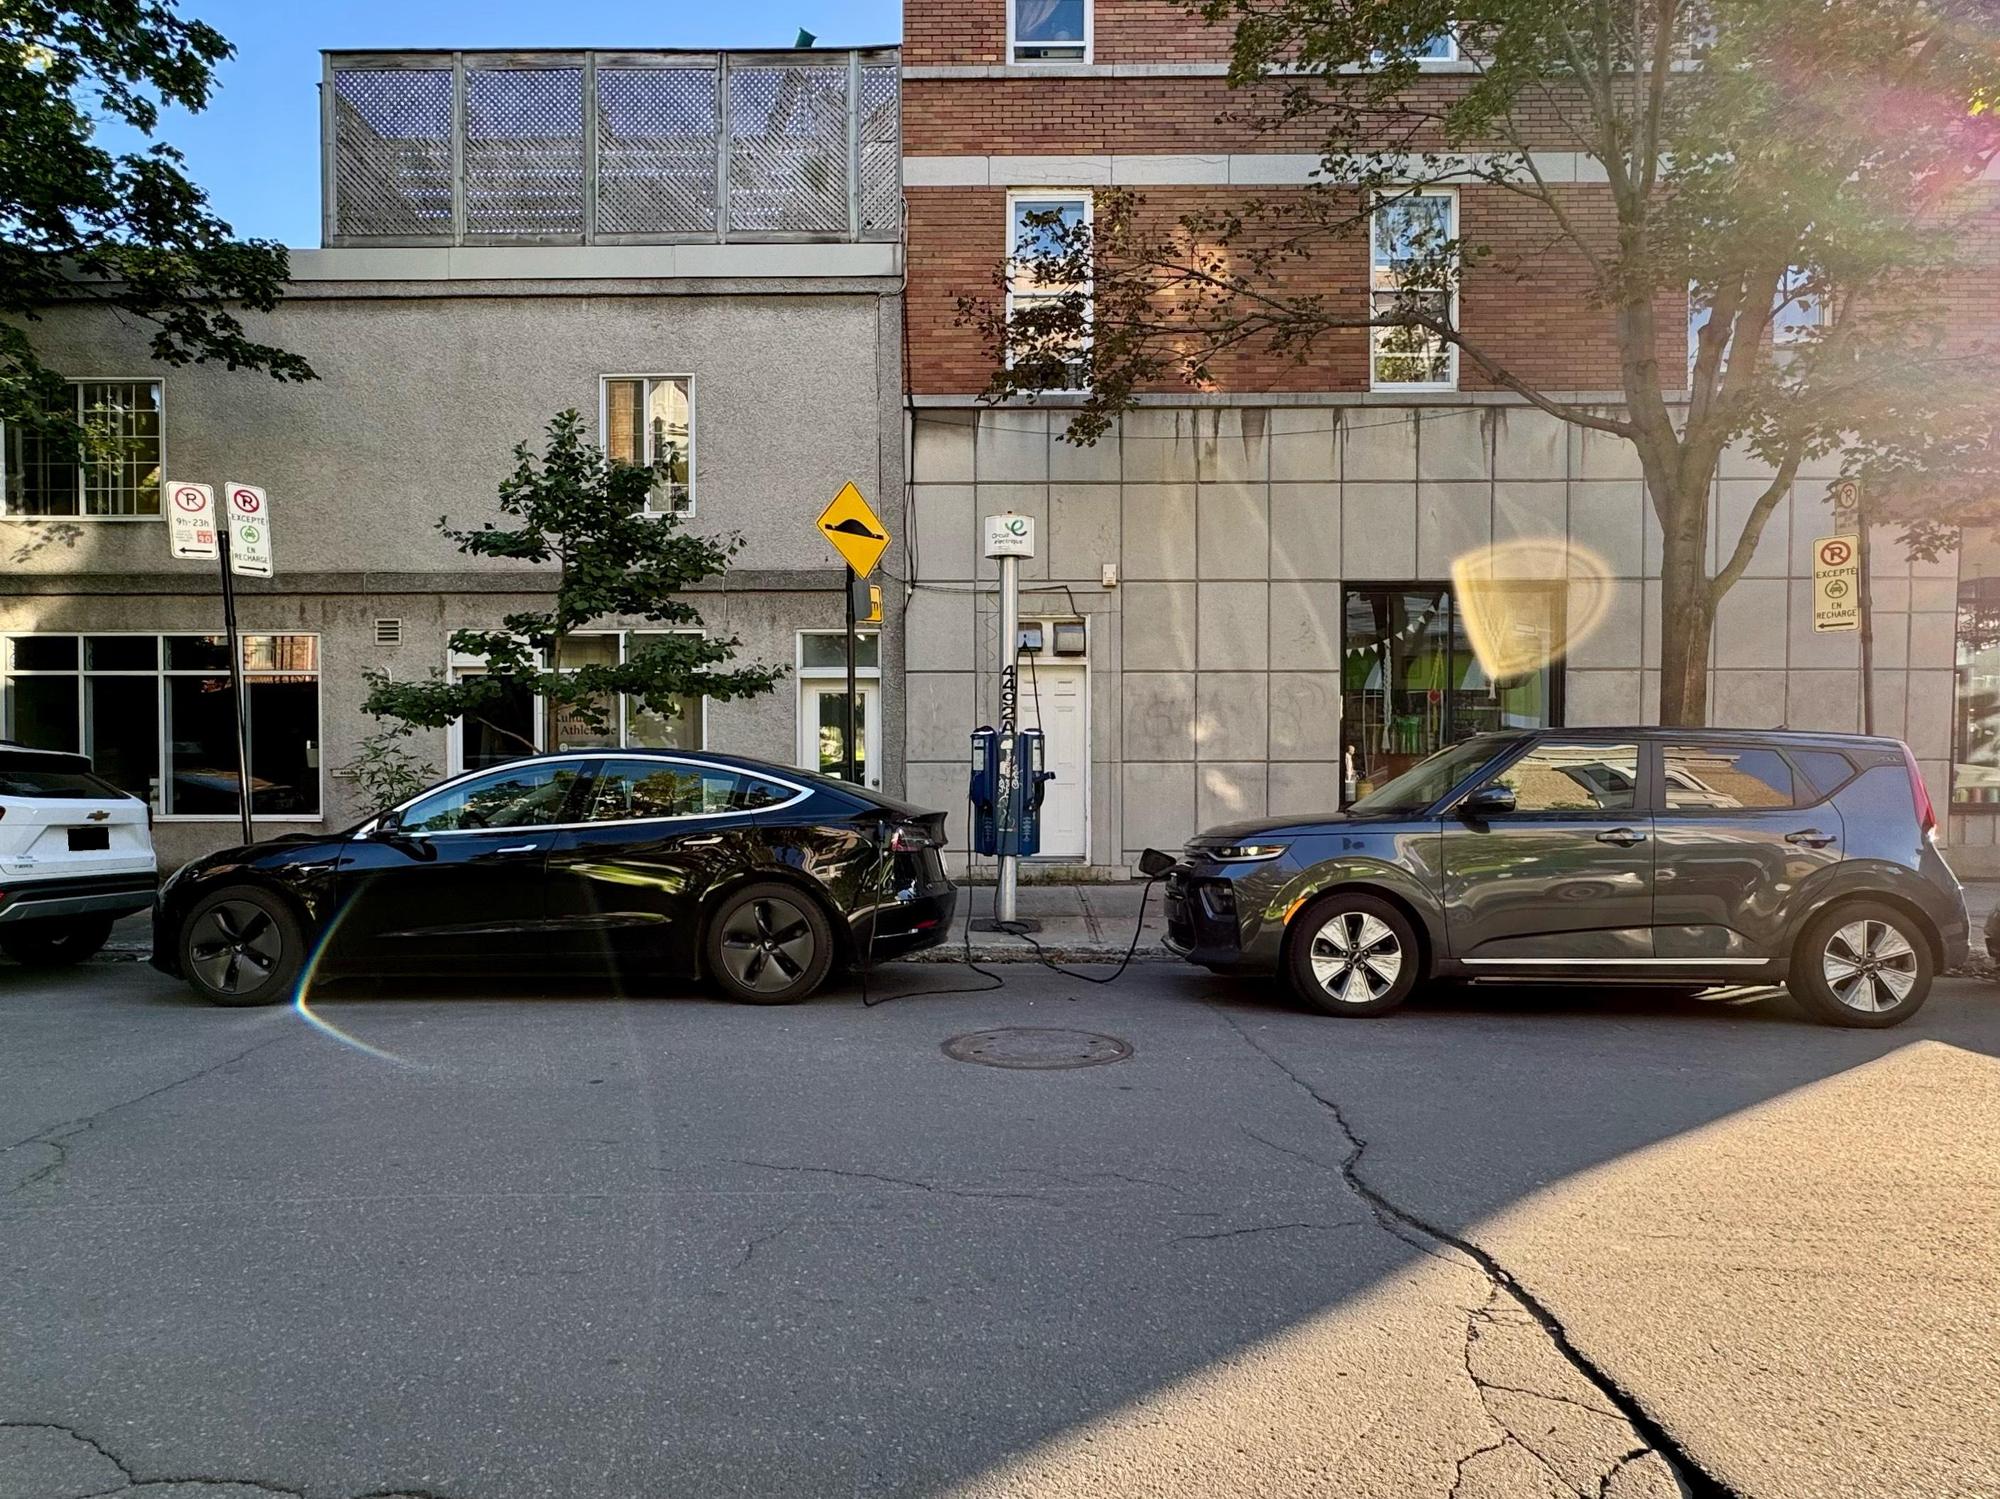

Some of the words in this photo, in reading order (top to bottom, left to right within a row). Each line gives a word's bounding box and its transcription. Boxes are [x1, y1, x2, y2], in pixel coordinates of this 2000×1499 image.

[1816, 566, 1857, 579] EXCEPTÉ
[1831, 602, 1842, 610] EN
[1816, 608, 1857, 619] RECHARGE
